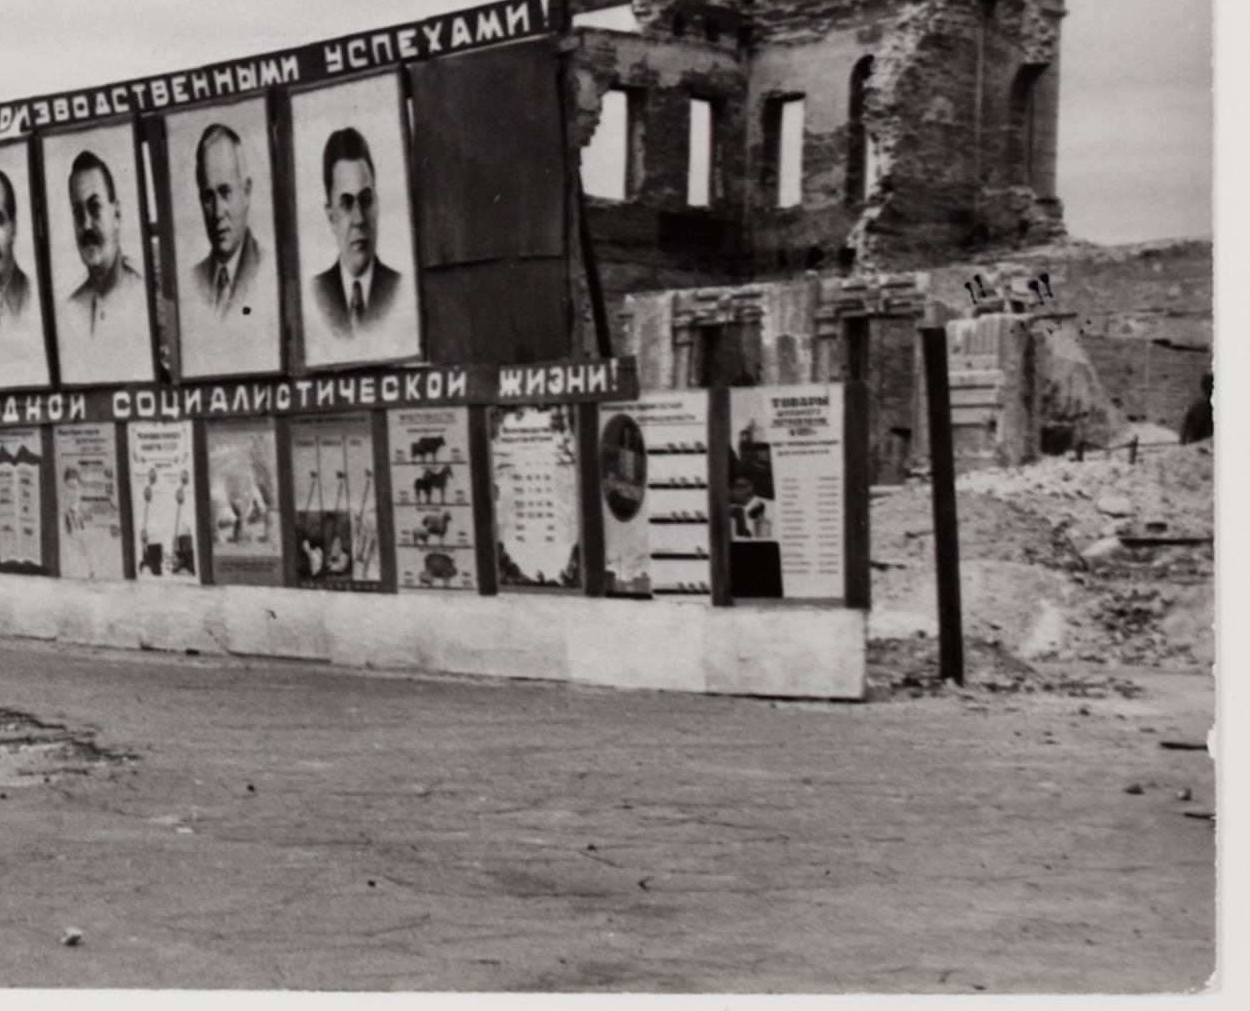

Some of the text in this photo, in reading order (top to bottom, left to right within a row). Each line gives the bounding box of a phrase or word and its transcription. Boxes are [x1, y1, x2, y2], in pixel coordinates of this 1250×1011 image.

[112, 364, 467, 419] СОЦИАЛИСТИЧЕСКОЙ
[499, 358, 619, 397] ЖИЗНИ!
[771, 396, 829, 408] ТОВАРЫ
